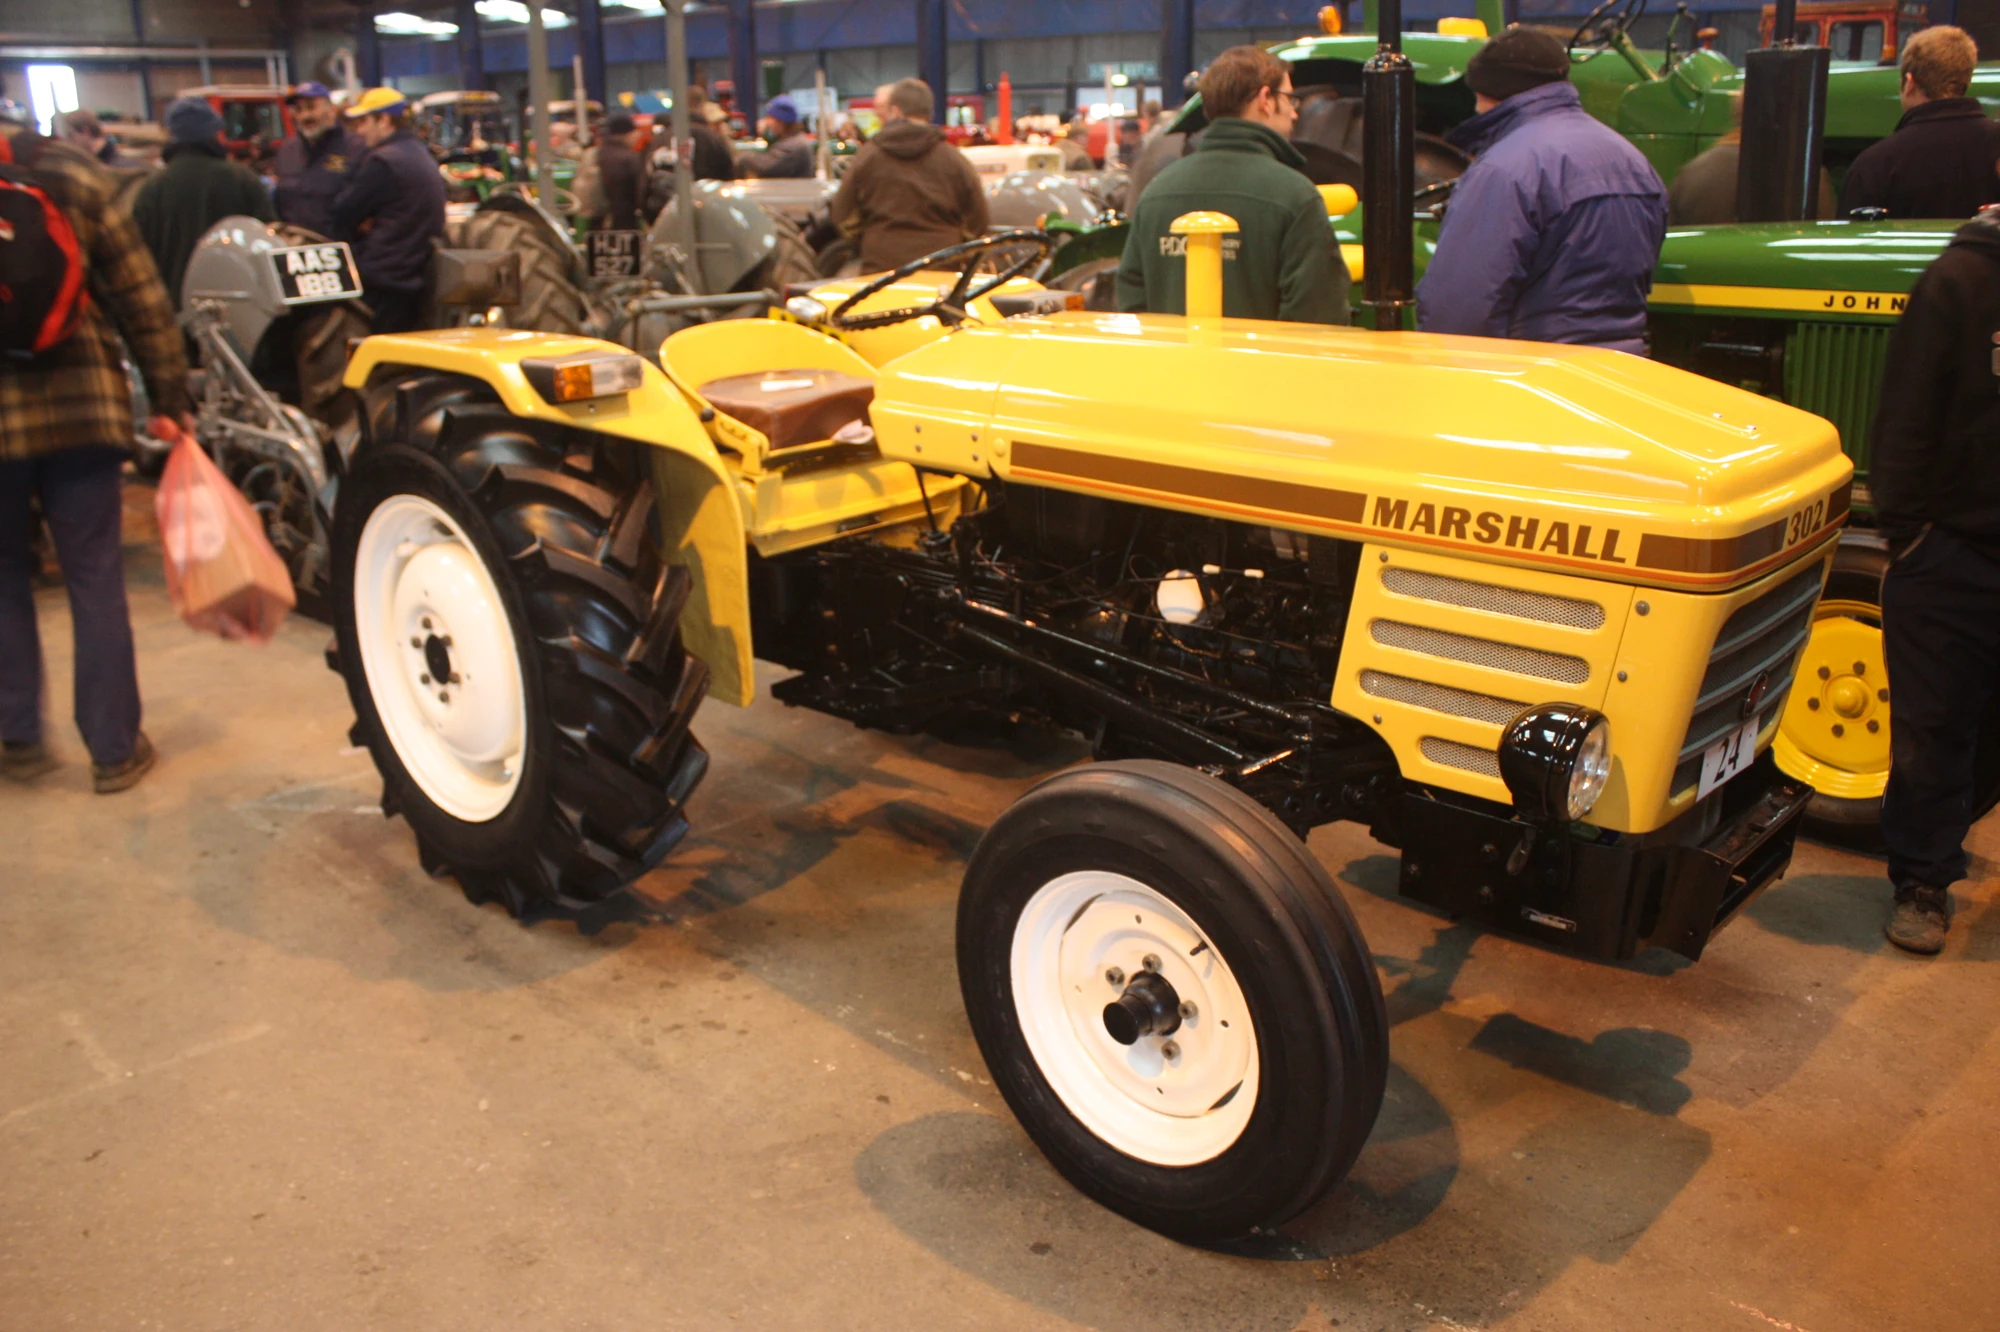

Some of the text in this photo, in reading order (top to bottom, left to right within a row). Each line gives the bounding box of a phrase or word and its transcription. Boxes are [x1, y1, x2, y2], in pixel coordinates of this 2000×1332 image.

[594, 233, 633, 255] HJT
[286, 247, 341, 275] AAS
[594, 255, 635, 276] 527
[1823, 294, 1906, 311] JOHN
[1372, 496, 1627, 564] MARSHALL
[1787, 499, 1824, 546] 302
[1713, 727, 1744, 784] 24
